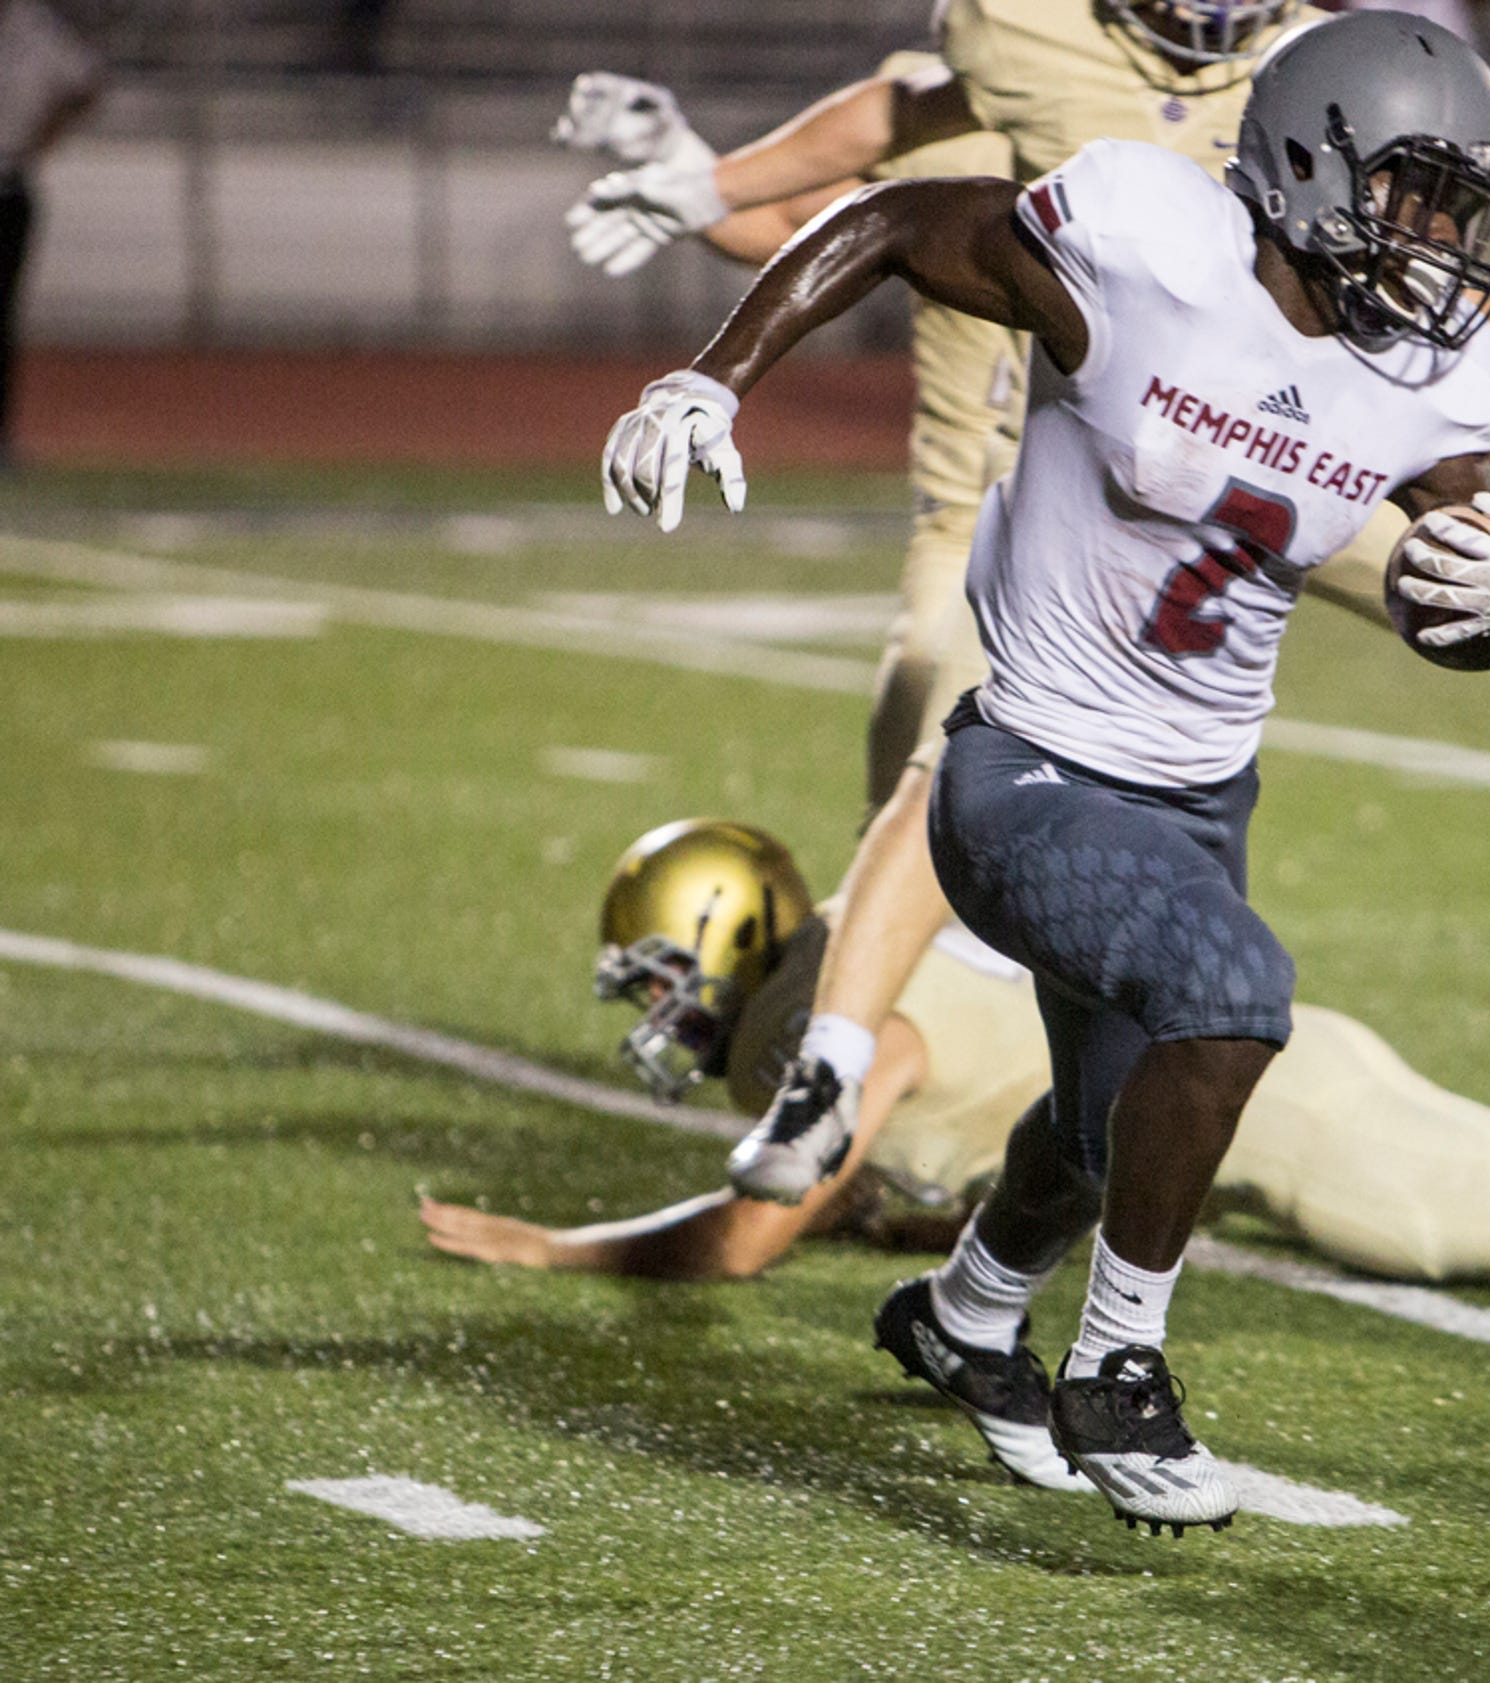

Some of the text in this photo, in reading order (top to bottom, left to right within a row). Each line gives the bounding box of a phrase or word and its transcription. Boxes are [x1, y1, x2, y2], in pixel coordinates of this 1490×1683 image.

[1140, 375, 1388, 505] MEMPHIS EAST
[1138, 475, 1297, 661] 2
